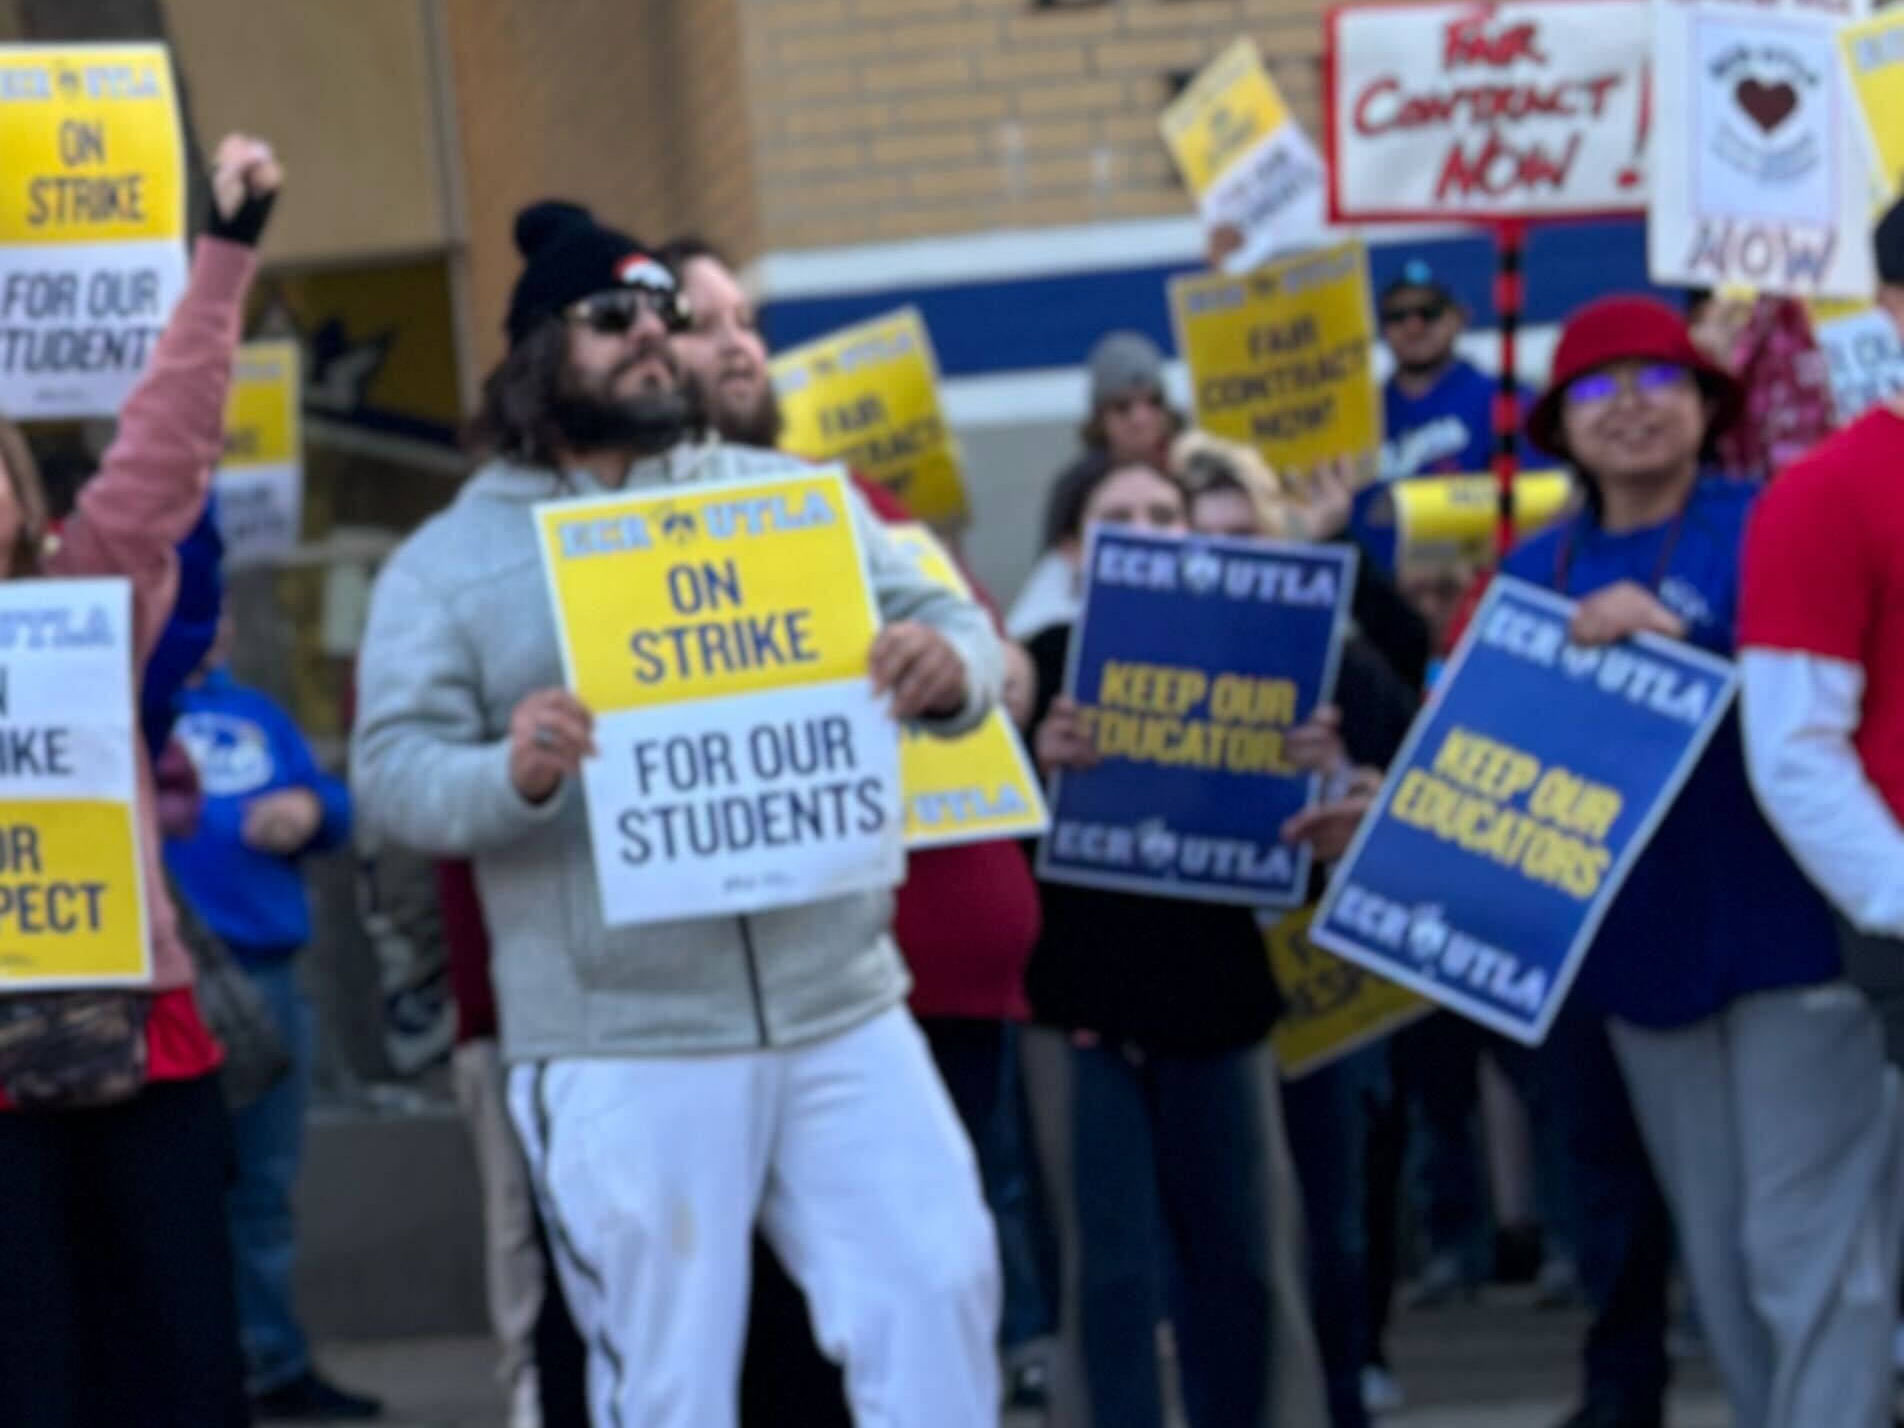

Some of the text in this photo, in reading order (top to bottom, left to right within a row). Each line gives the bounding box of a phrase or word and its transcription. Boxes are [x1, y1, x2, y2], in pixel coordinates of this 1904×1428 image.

[58, 119, 106, 165] ON
[27, 174, 146, 227] STRIKE
[1688, 220, 1838, 292] NOW
[1, 269, 160, 320] FOR OUR
[558, 490, 837, 559] ECR UTLA
[666, 557, 743, 615] ON
[1097, 542, 1336, 605] ECR UTLA
[629, 608, 819, 685] STRIKE
[1481, 602, 1710, 725] ECR UTLA
[1100, 659, 1297, 728] KEEP OUR
[633, 714, 856, 799] FOR OUR
[1434, 725, 1623, 838] KEEP OUR
[617, 776, 885, 866] STUDENTS
[913, 780, 1028, 824] UTLA
[1389, 768, 1612, 901] EDUCATORS
[1053, 821, 1291, 884] ECR UTLA
[1333, 882, 1409, 947] ECR
[1441, 930, 1548, 1012] UTLA
